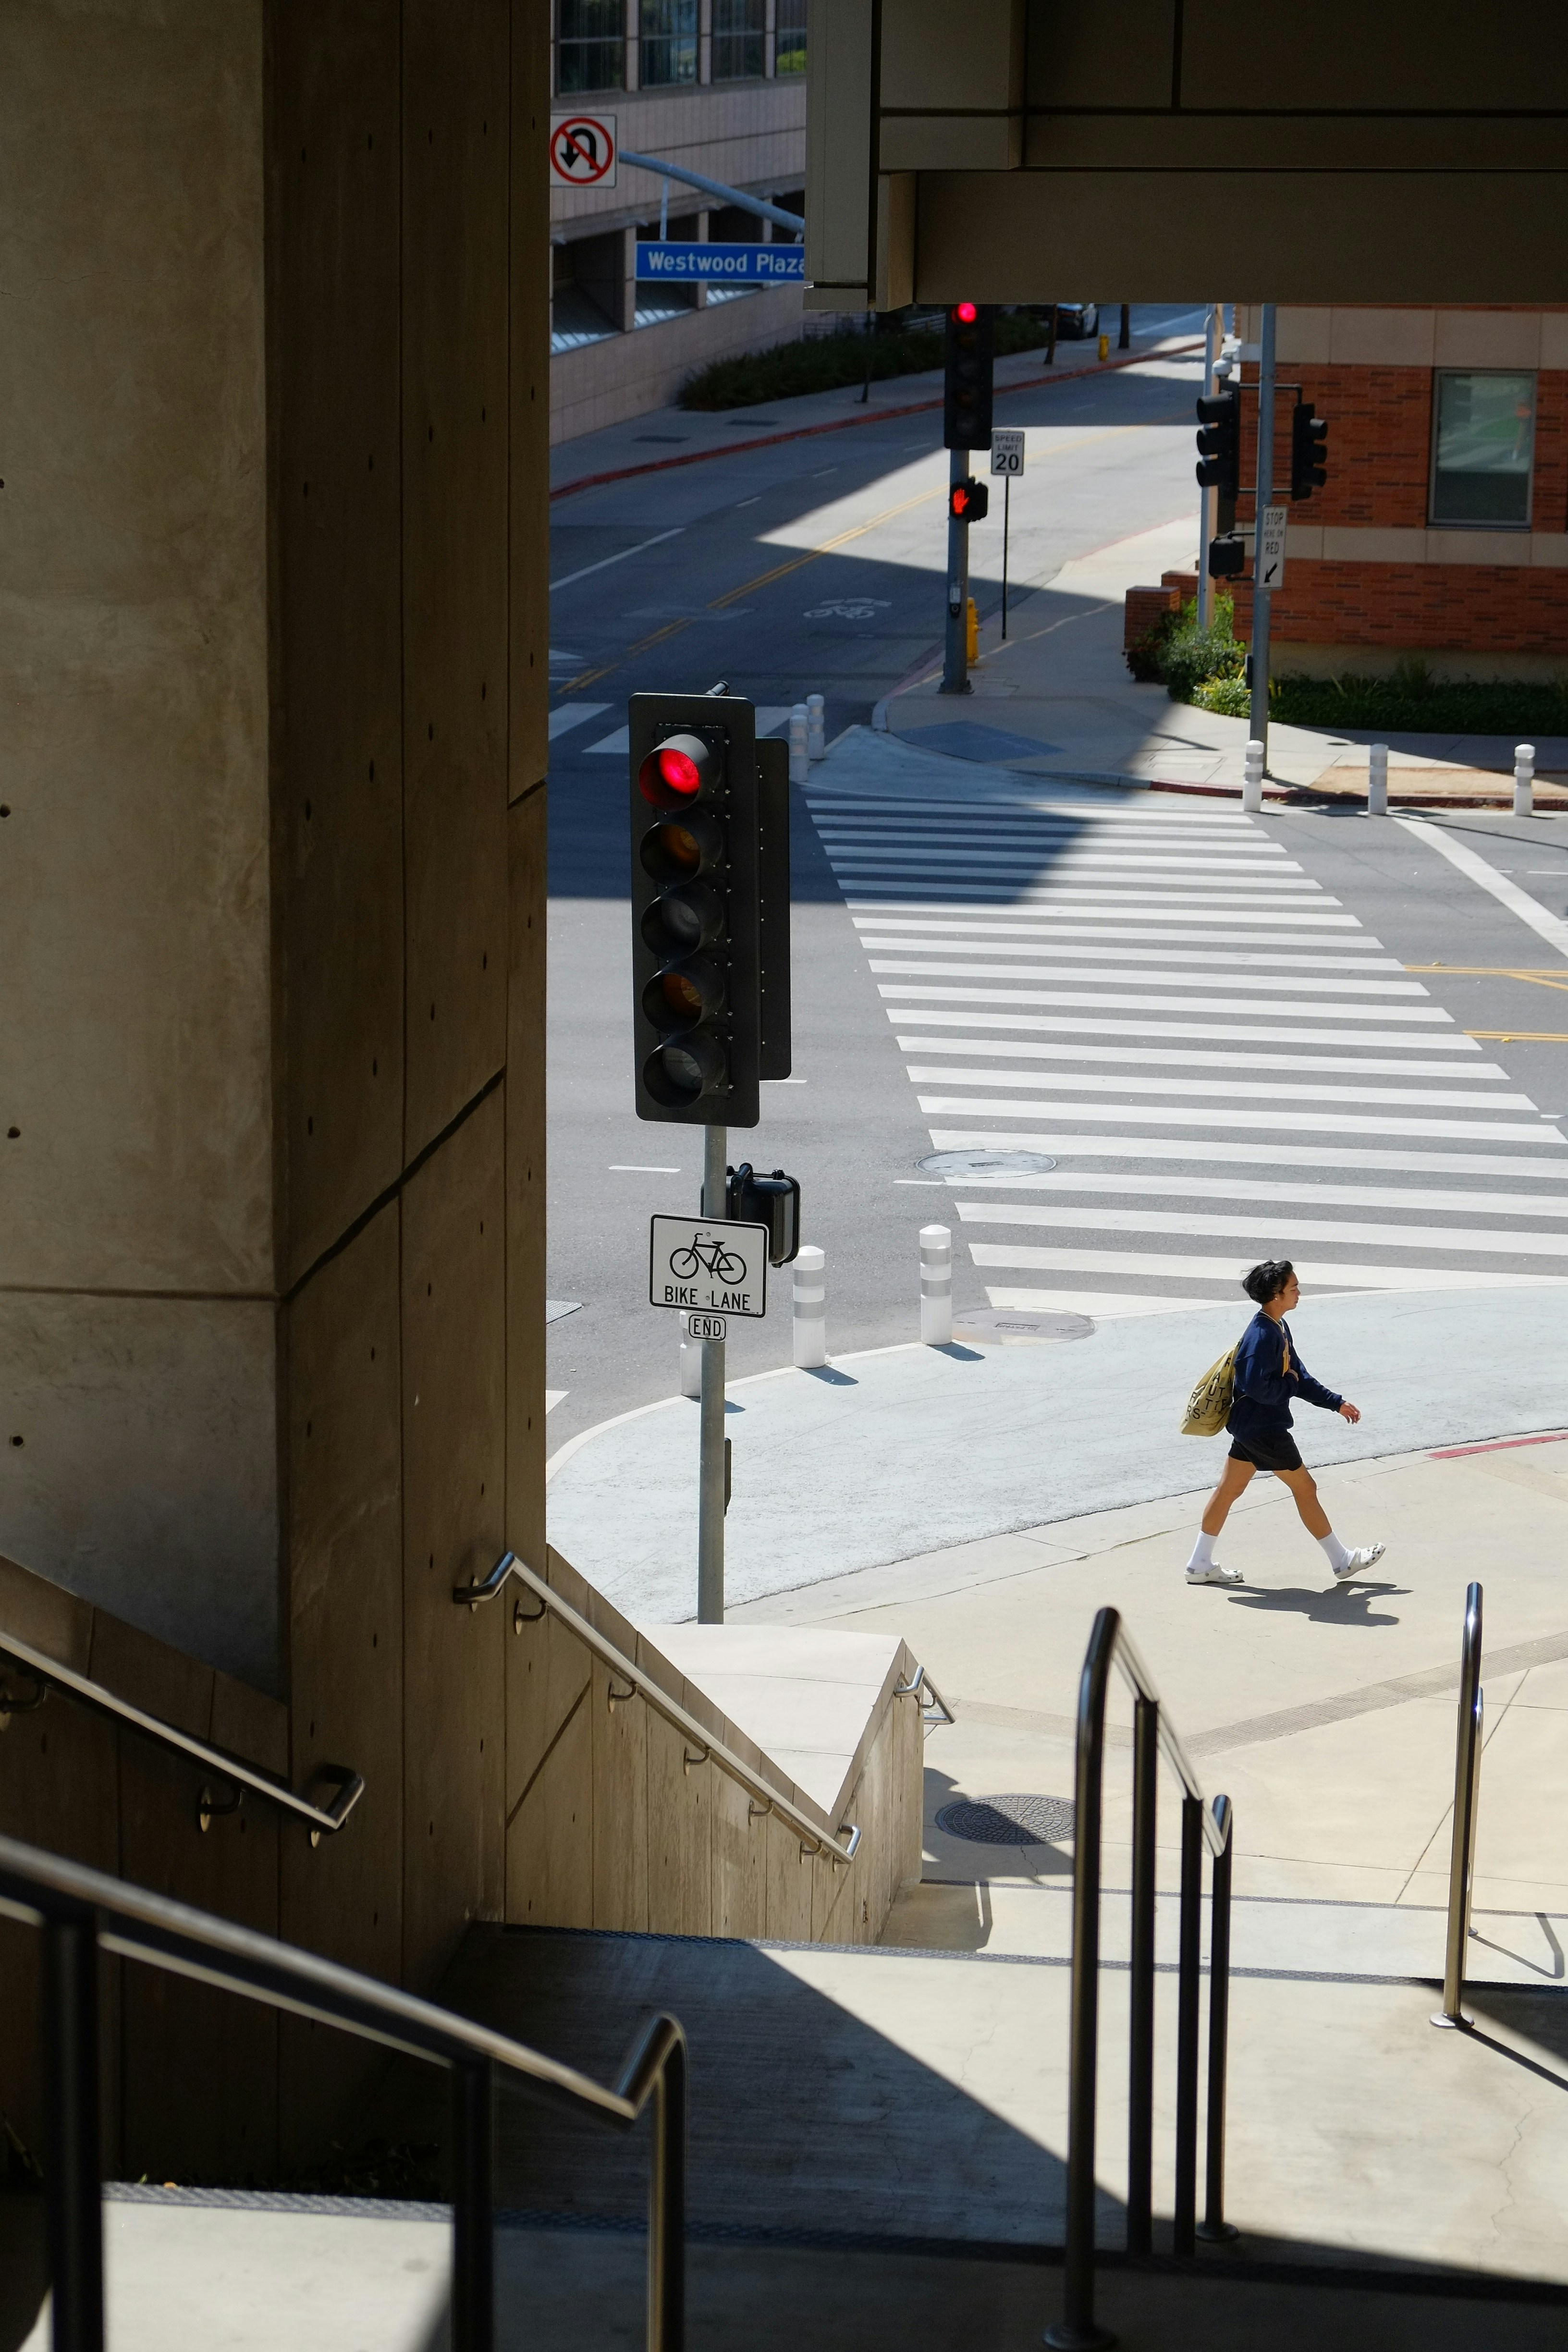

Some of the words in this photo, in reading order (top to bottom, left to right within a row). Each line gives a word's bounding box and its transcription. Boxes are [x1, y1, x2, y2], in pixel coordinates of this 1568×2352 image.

[649, 251, 747, 273] Westwood
[995, 453, 1019, 471] 20
[1266, 512, 1284, 526] STOP
[1265, 541, 1279, 554] RED
[664, 1285, 698, 1305] BIKE
[711, 1290, 750, 1311] LANE
[693, 1318, 721, 1336] END
